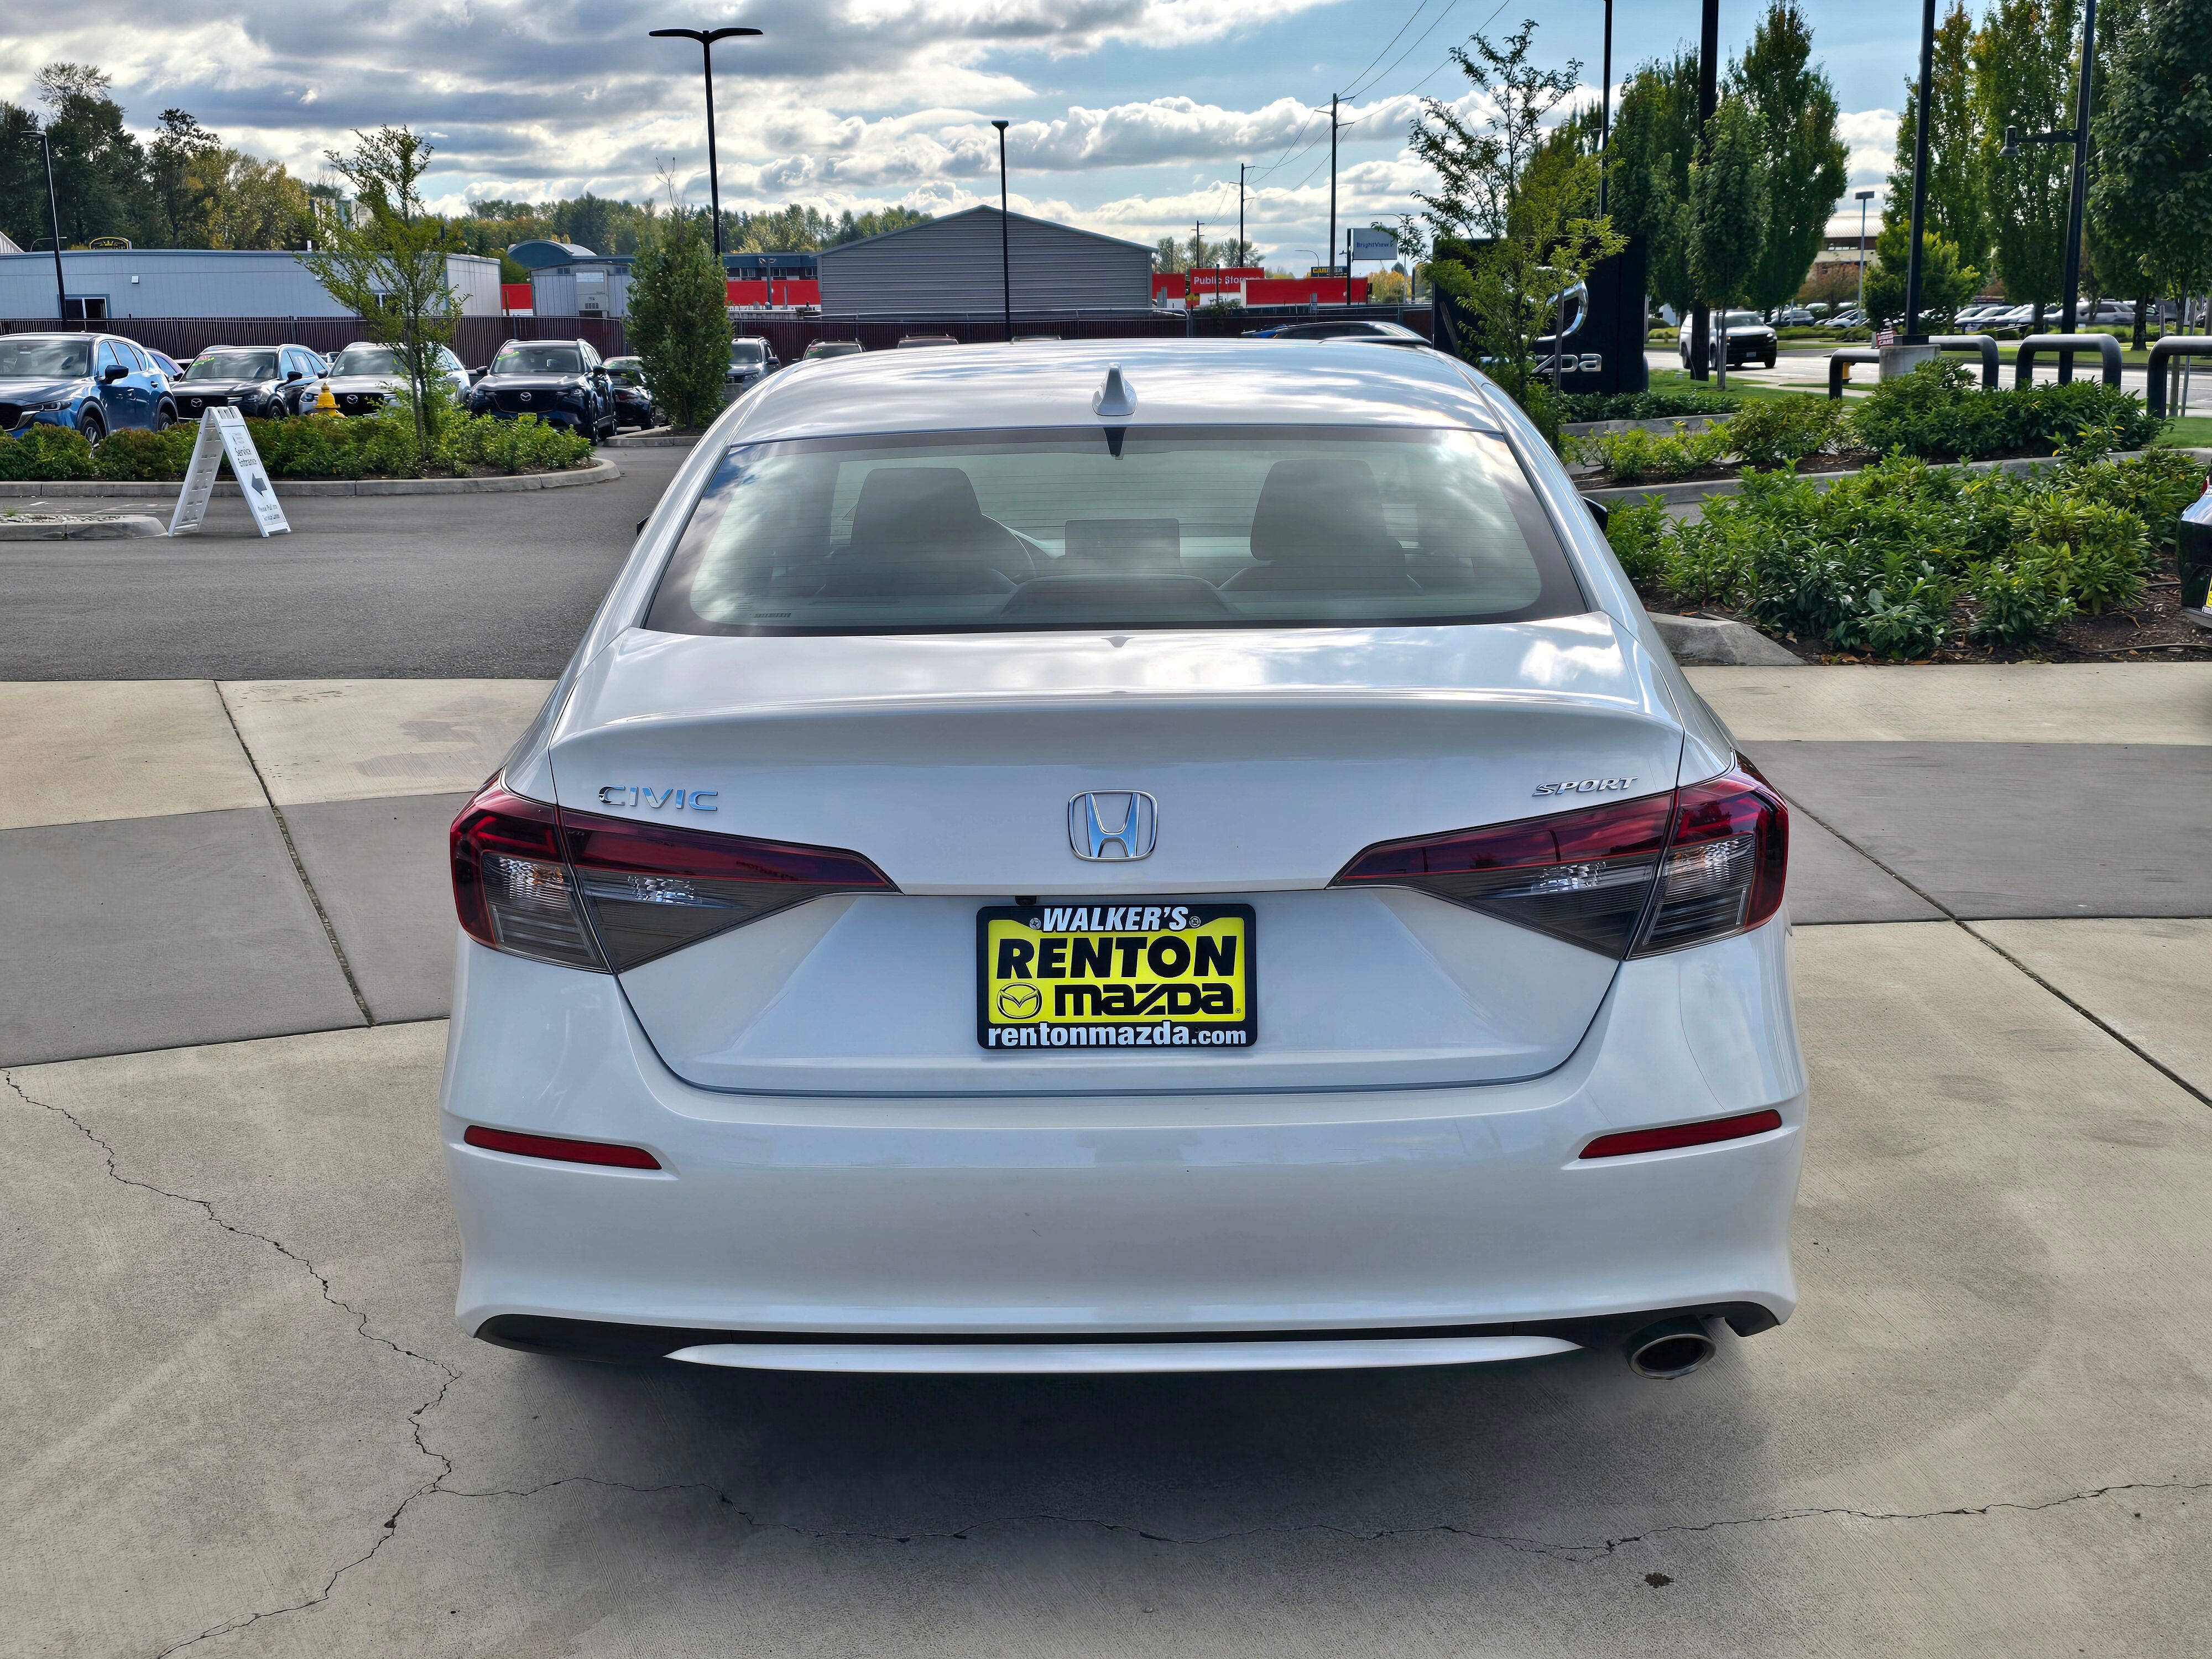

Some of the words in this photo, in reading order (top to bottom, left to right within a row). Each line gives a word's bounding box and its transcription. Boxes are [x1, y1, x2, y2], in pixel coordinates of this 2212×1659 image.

[599, 785, 718, 811] CIVIC
[1532, 776, 1638, 797] SPORT
[1044, 906, 1188, 931] WALKER'S
[997, 936, 1237, 979] RENTON
[988, 1021, 1246, 1046] rentonmazda.com
